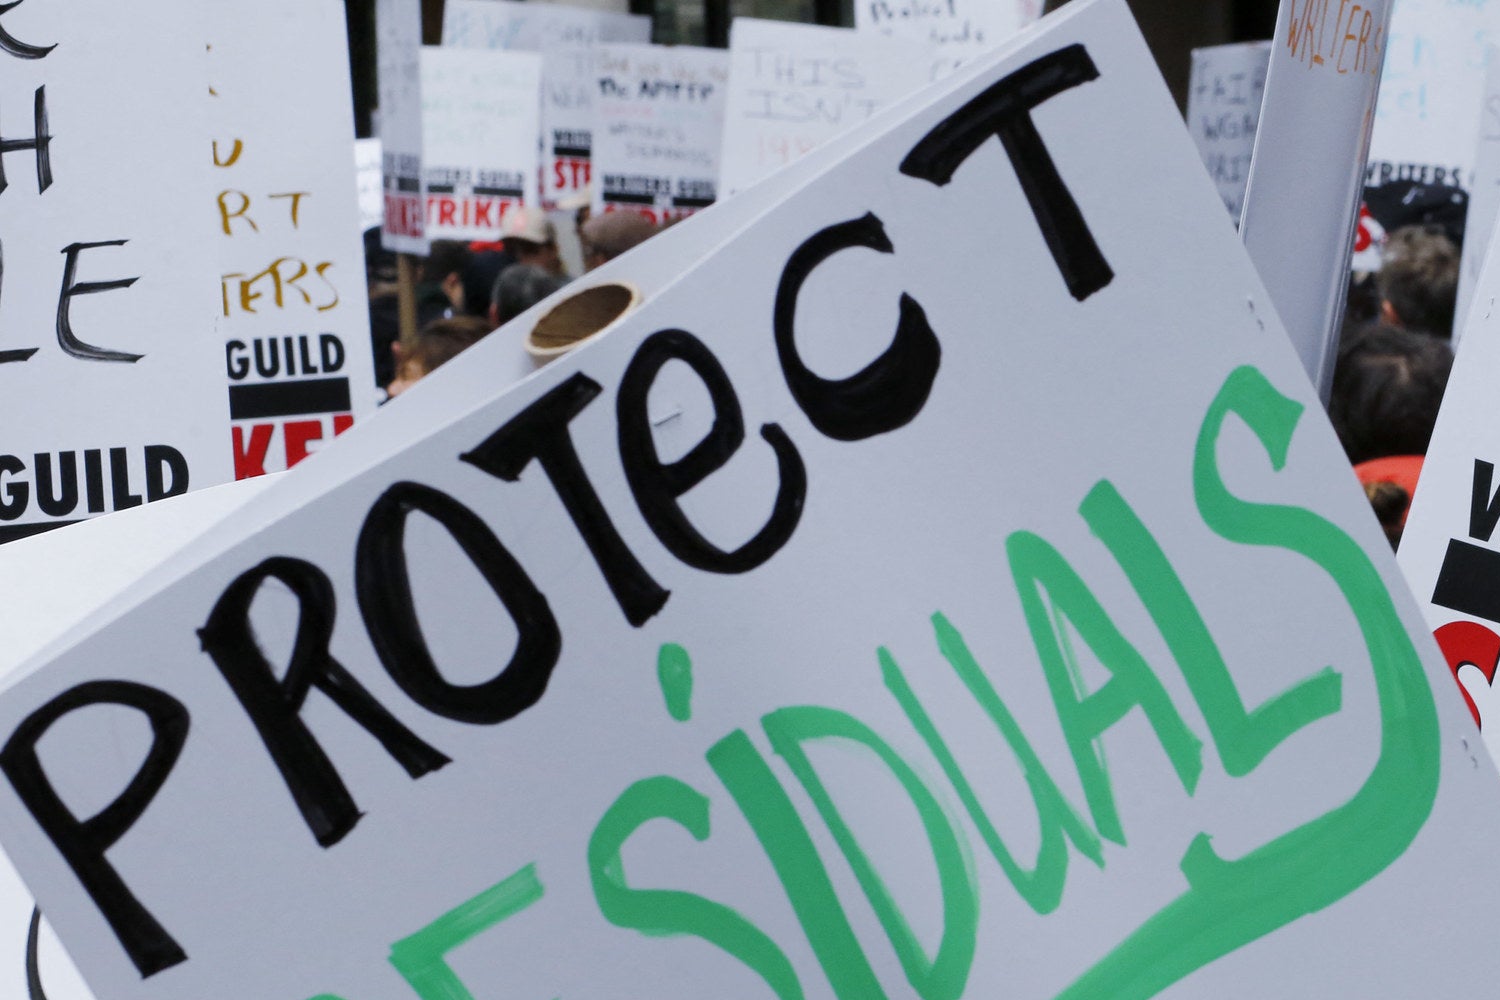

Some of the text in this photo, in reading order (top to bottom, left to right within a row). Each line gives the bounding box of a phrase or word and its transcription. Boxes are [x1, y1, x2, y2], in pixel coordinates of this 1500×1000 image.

[1287, 0, 1383, 76] WRITERS
[226, 334, 345, 381] GUILD
[0, 445, 189, 519] GUILD
